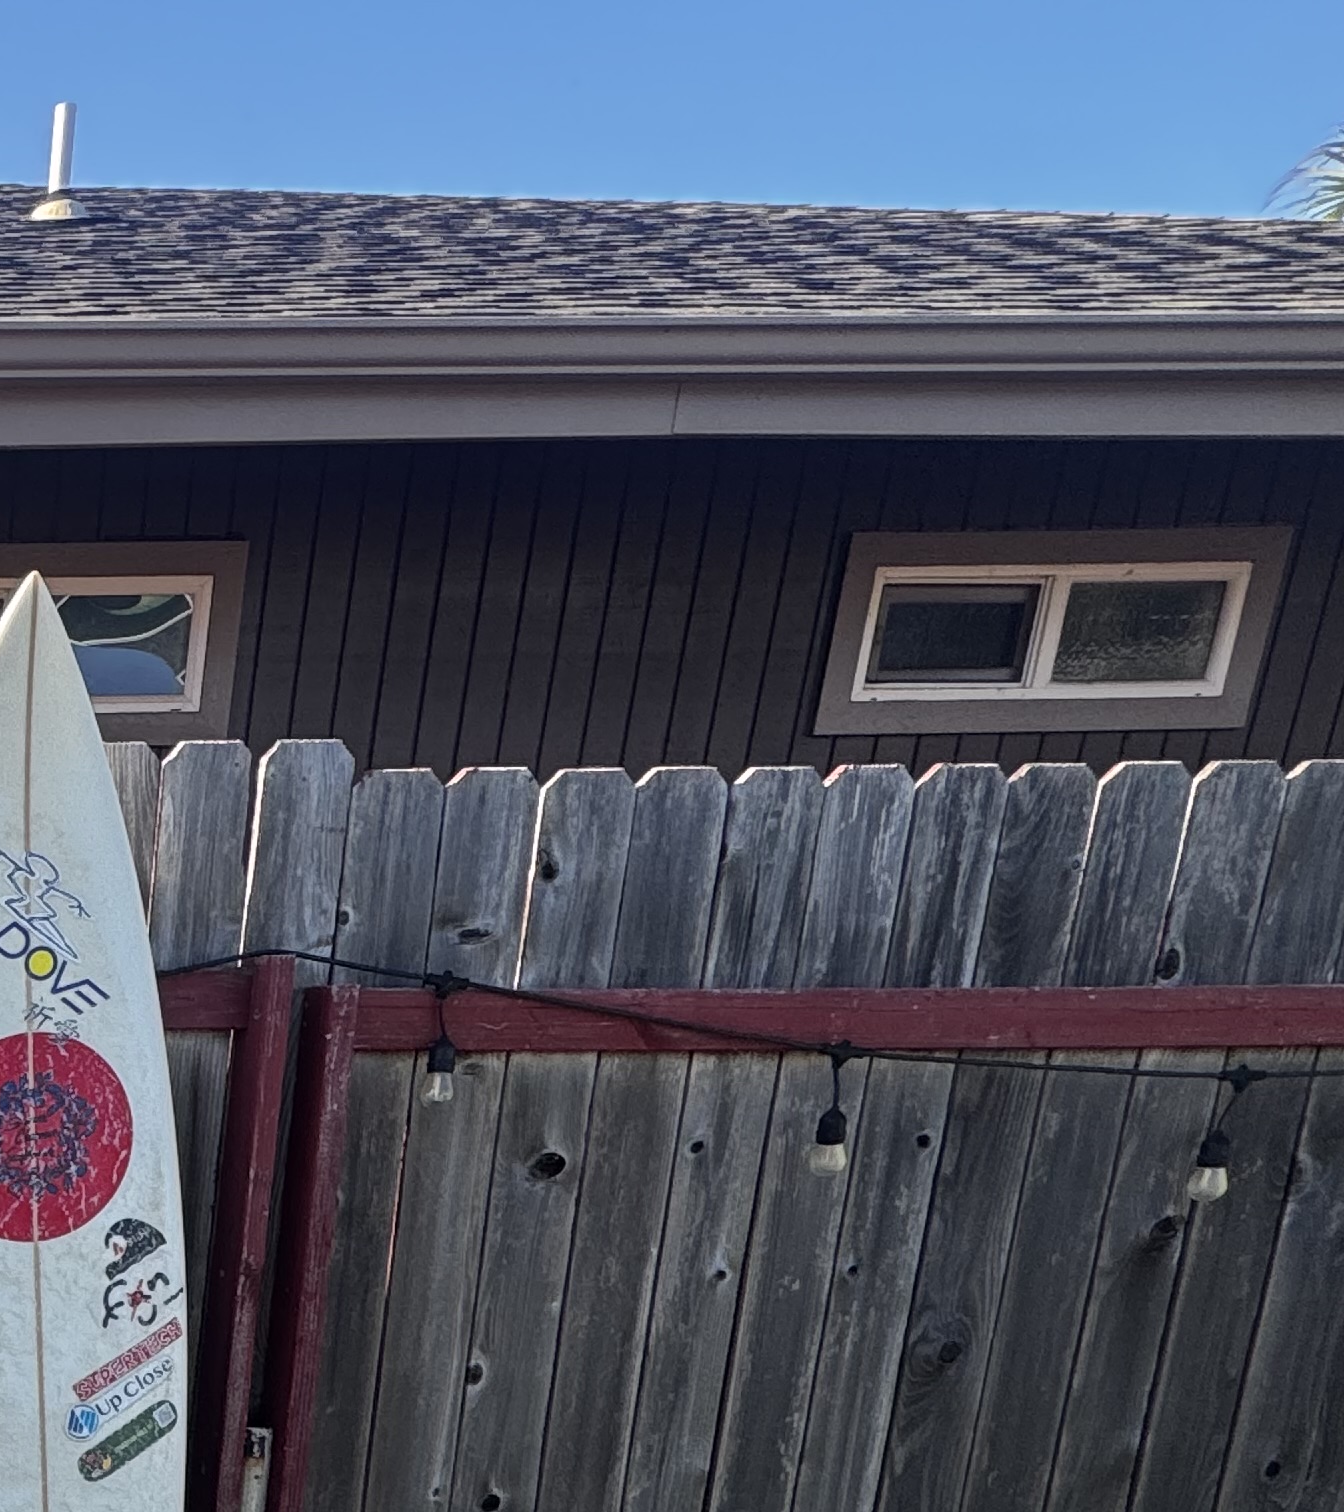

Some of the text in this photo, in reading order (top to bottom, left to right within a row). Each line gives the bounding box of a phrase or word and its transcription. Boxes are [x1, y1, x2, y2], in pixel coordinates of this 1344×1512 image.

[75, 1319, 183, 1400] SUPERTECH
[95, 1358, 173, 1417] Up Close
